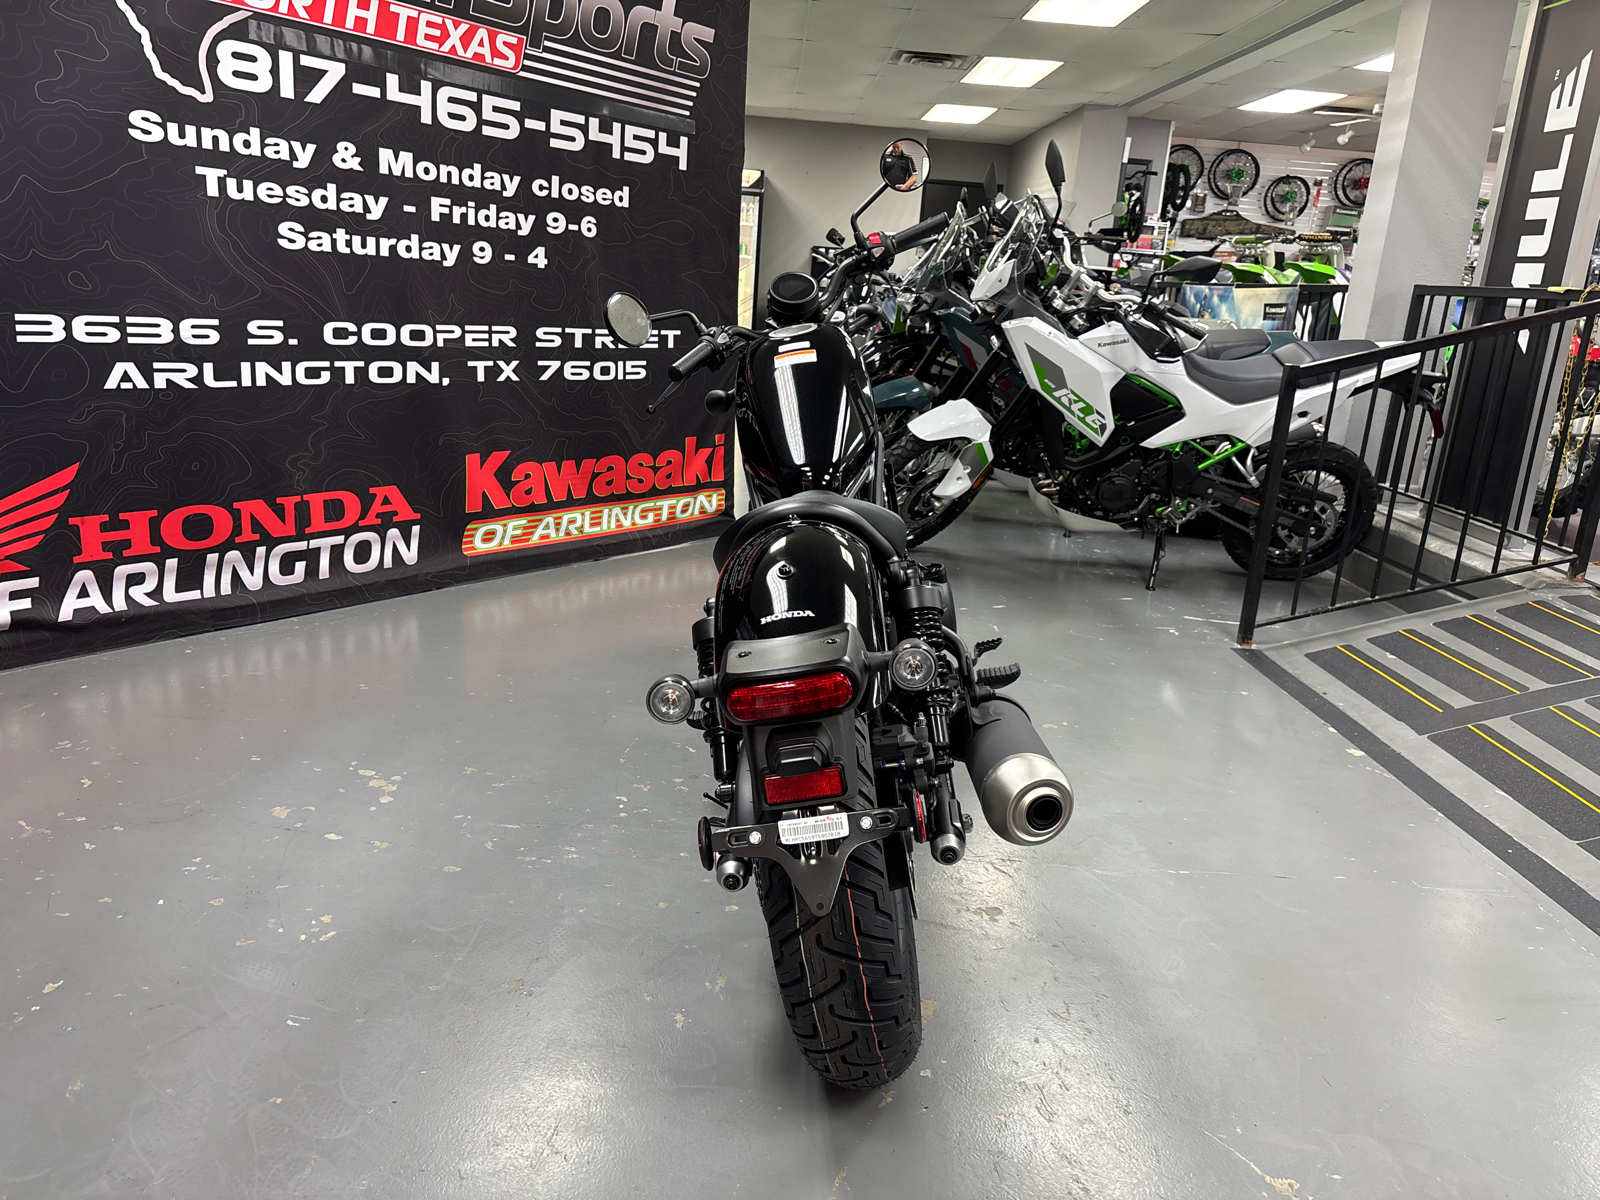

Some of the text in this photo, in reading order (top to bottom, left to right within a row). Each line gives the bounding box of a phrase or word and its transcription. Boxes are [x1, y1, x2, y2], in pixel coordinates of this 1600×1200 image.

[389, 4, 518, 68] TEXAS
[216, 39, 688, 171] 817-465-5454
[128, 110, 630, 208] Sunday & Monday closed
[195, 166, 389, 221] Tuesday
[431, 197, 536, 236] Friday
[546, 212, 598, 238] 9-6
[277, 222, 461, 267] Saturday
[472, 241, 493, 264] 9
[527, 247, 548, 269] 4
[15, 314, 681, 349] 3636 S. COOPER STRET
[1097, 337, 1130, 348] Kawasaki
[103, 360, 647, 389] ARLINGTON, TX 76015
[465, 433, 725, 514] Kawasaki
[68, 485, 421, 563] HONDA
[474, 493, 718, 549] OF ARLINGTON
[58, 525, 421, 623] ARLINGTON
[760, 610, 816, 625] HONDA
